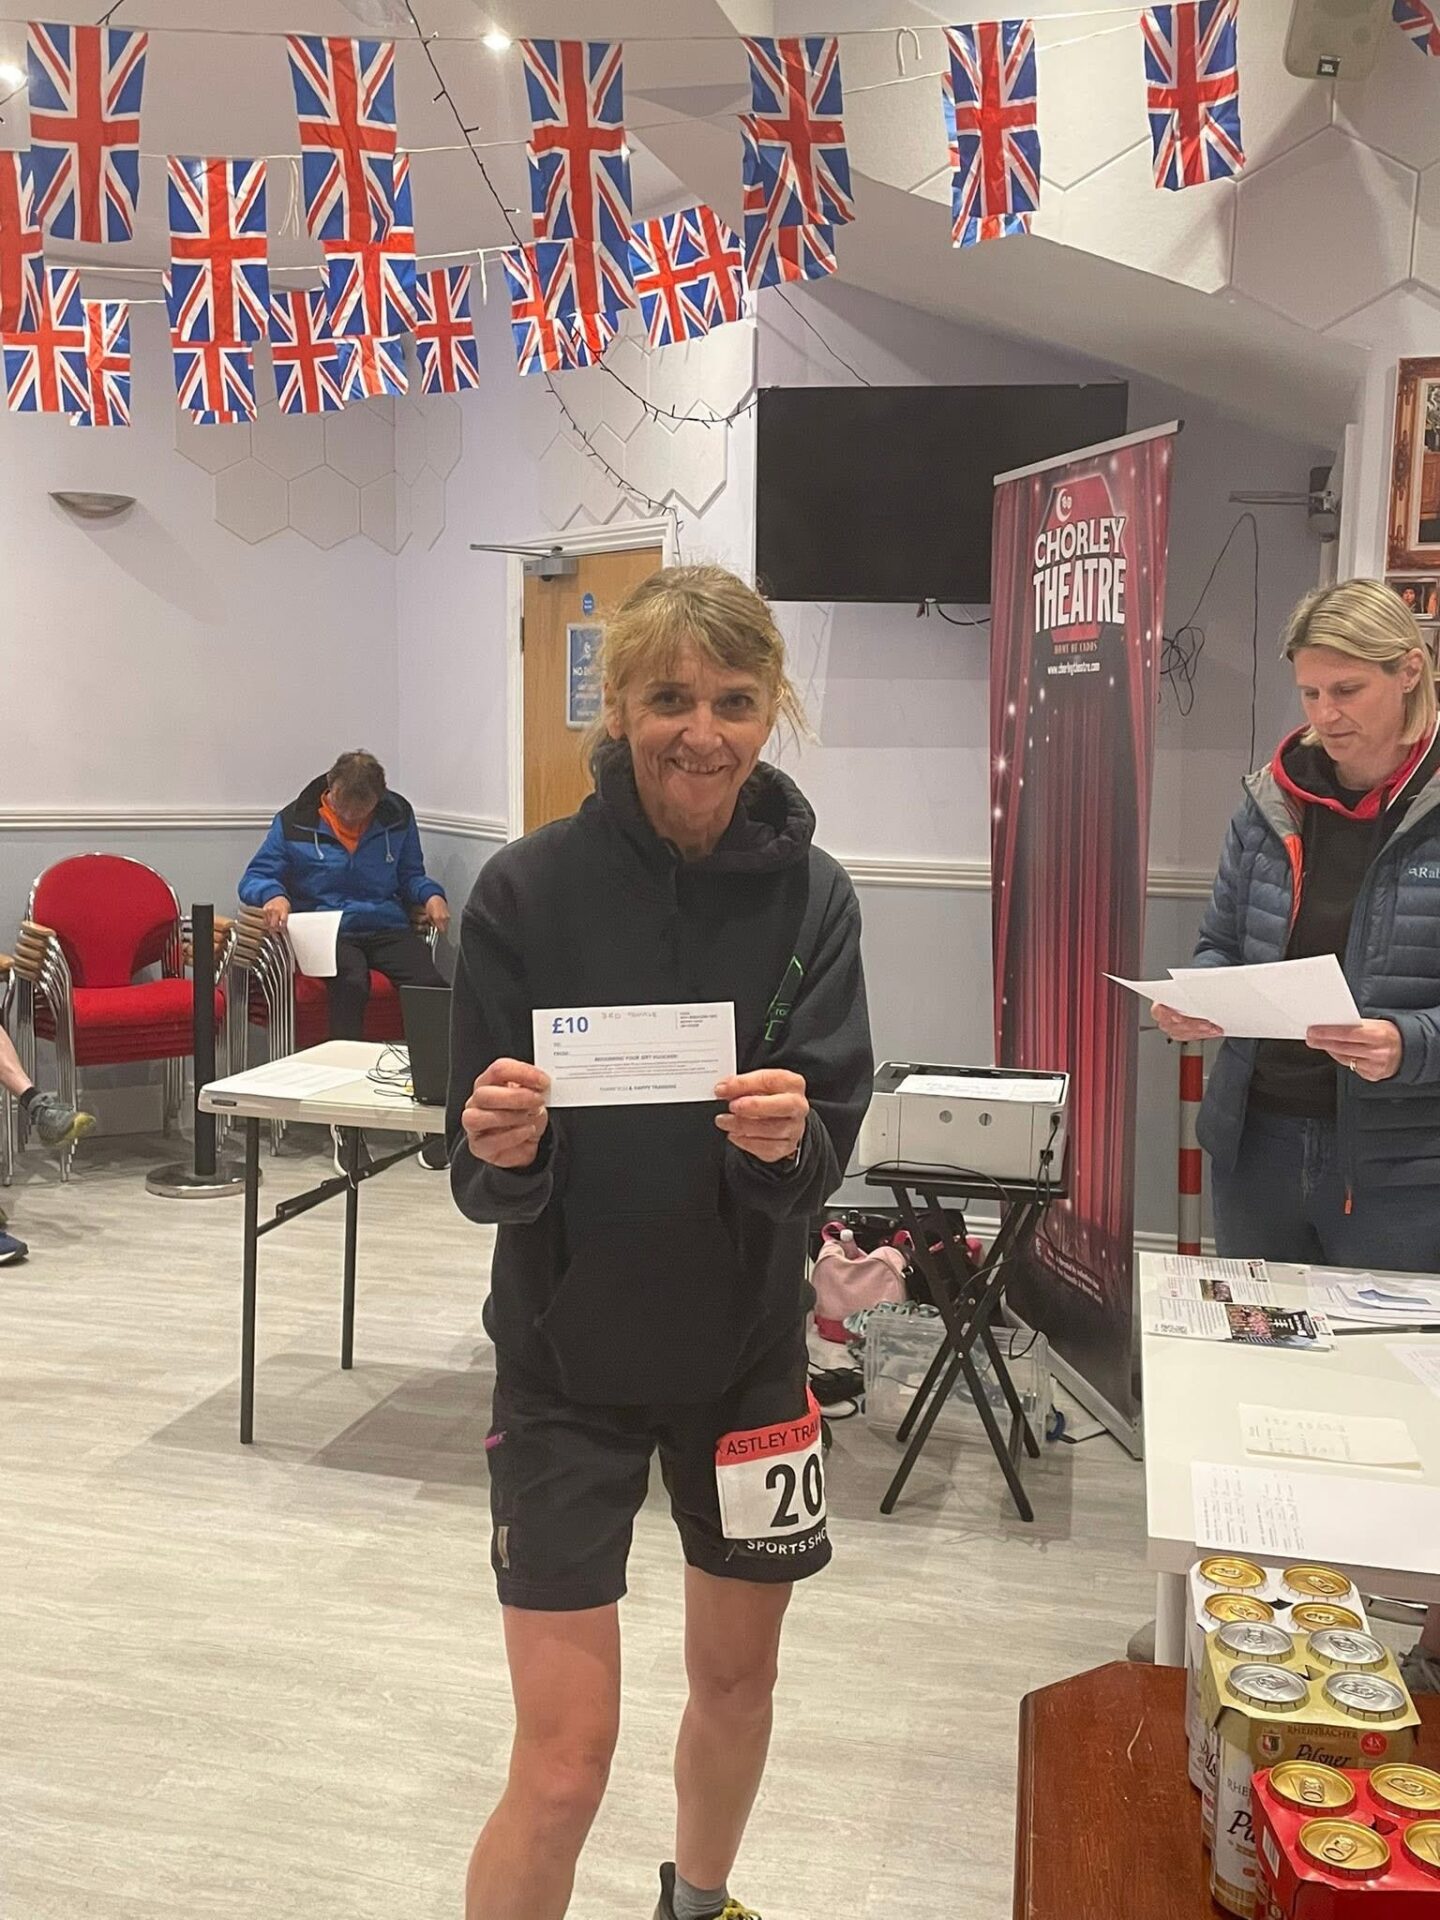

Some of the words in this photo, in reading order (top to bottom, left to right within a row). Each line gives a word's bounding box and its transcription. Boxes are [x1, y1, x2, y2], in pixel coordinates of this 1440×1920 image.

[1035, 517, 1126, 569] CHORLEY
[1033, 558, 1126, 634] THEATRE
[552, 1016, 589, 1034] £10
[727, 1431, 787, 1456] ASTLEY
[1287, 1724, 1359, 1739] RHEINBACHER
[1295, 1744, 1352, 1767] Pilsner
